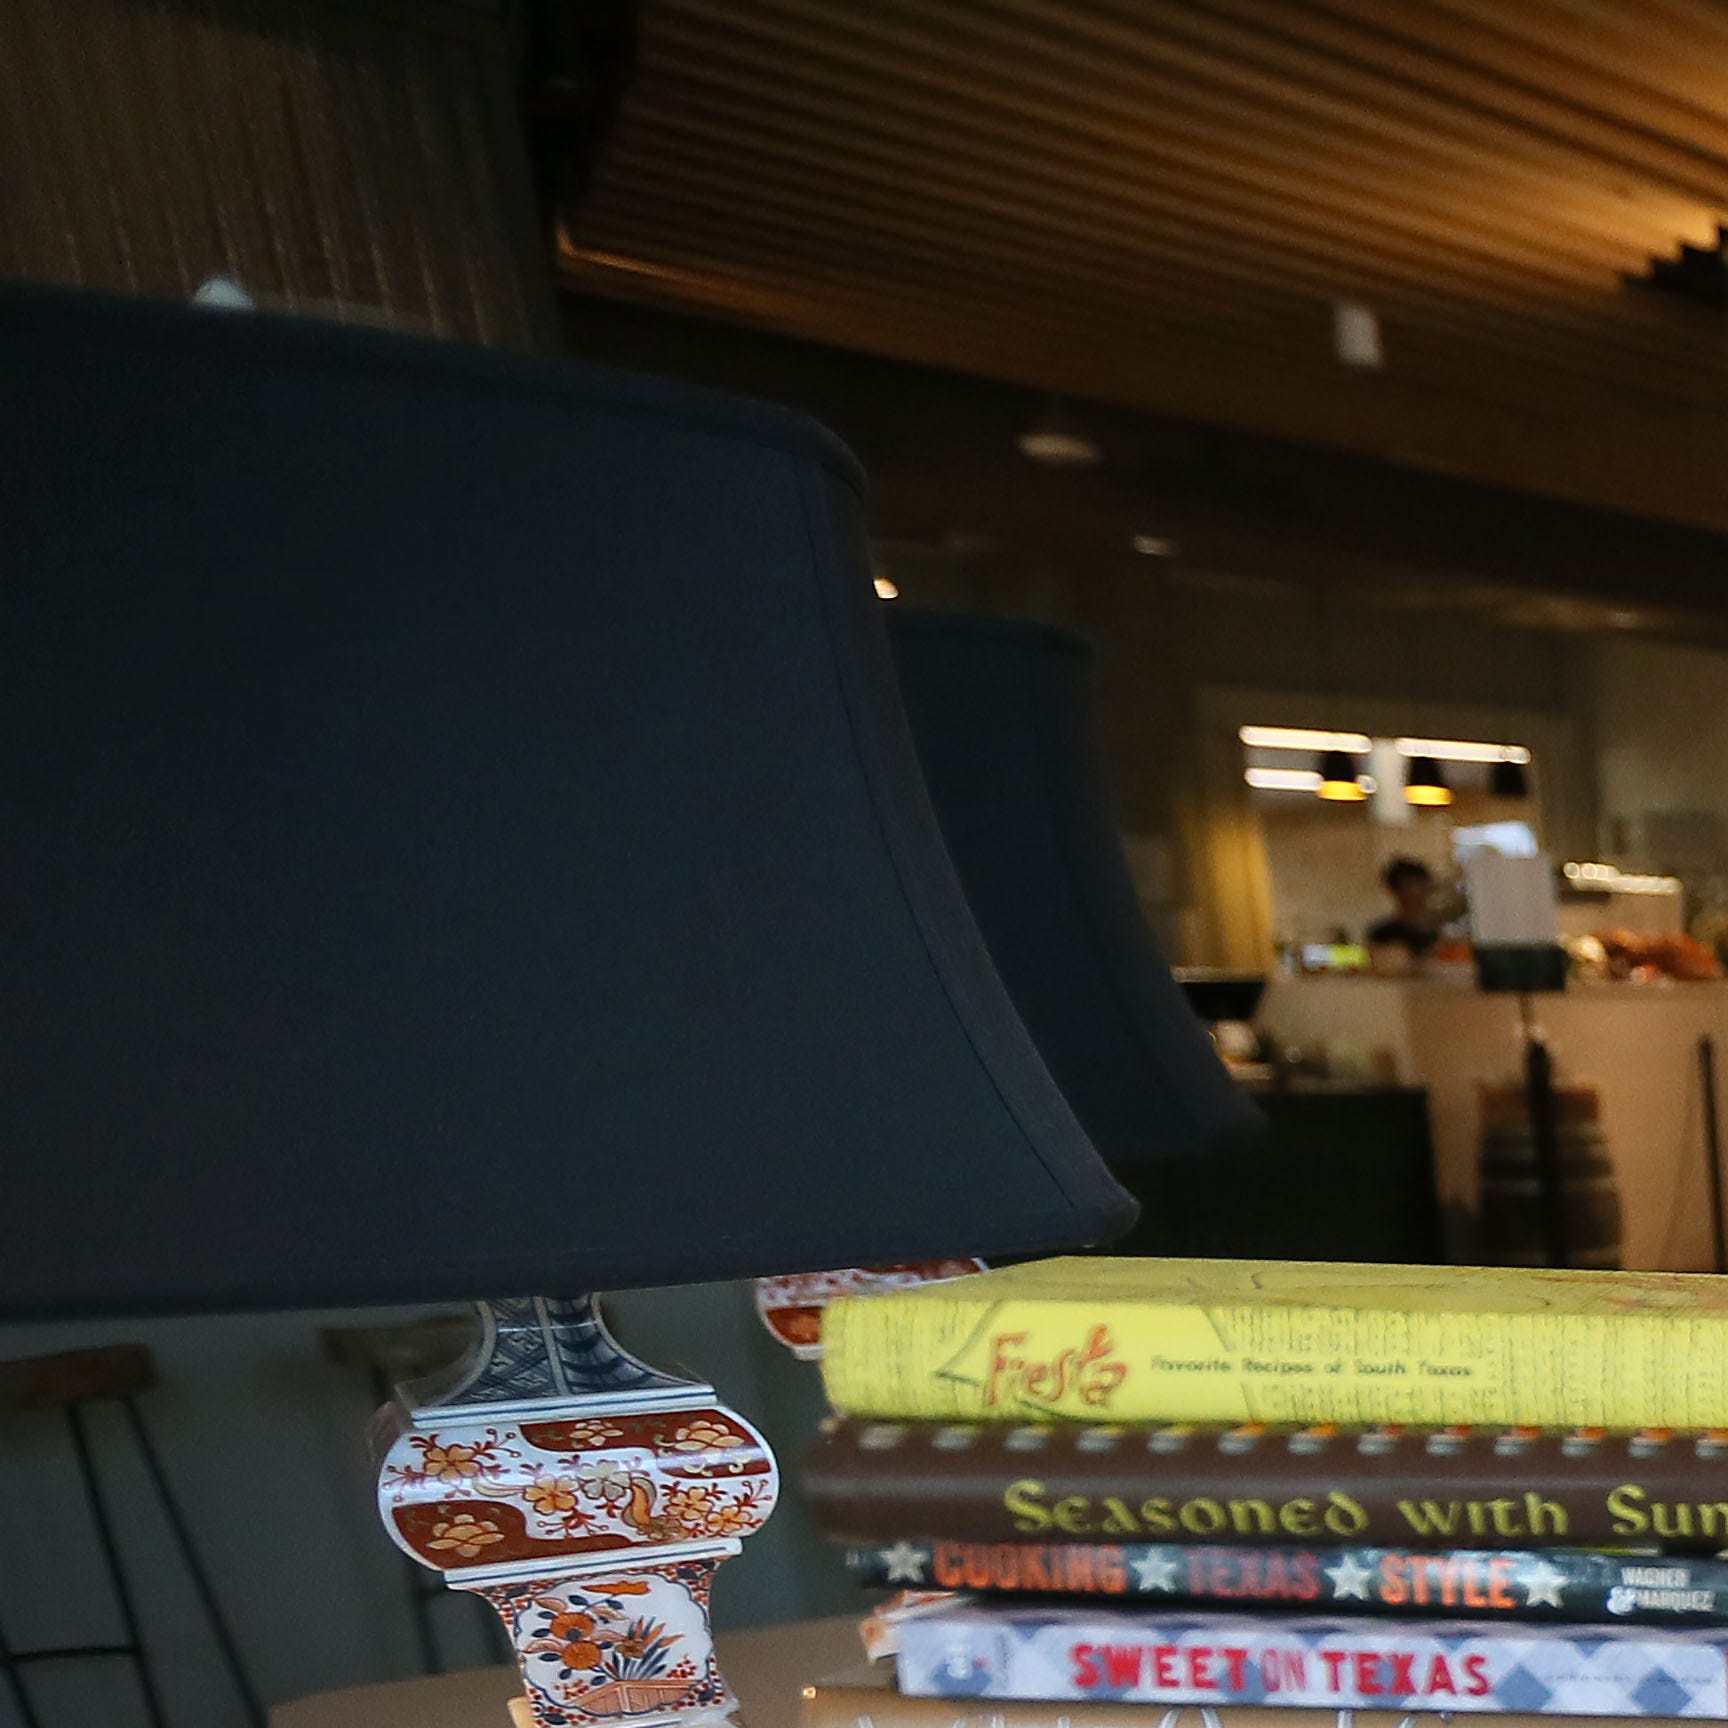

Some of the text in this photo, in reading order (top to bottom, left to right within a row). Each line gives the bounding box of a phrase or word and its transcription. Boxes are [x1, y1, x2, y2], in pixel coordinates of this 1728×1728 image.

[983, 1323, 1129, 1408] Fiesta
[1152, 1354, 1231, 1375] Favorite
[1242, 1357, 1313, 1378] Recipes
[1354, 1358, 1406, 1377] South
[1003, 1478, 1370, 1538] Seasoned
[1396, 1490, 1569, 1538] with
[933, 1544, 1517, 1610] COOKING TEXAS STYLE
[1620, 1566, 1692, 1589] WAGNER
[1069, 1643, 1248, 1692] SWEET
[1261, 1647, 1308, 1695] ON
[1321, 1649, 1494, 1697] TEXAS
